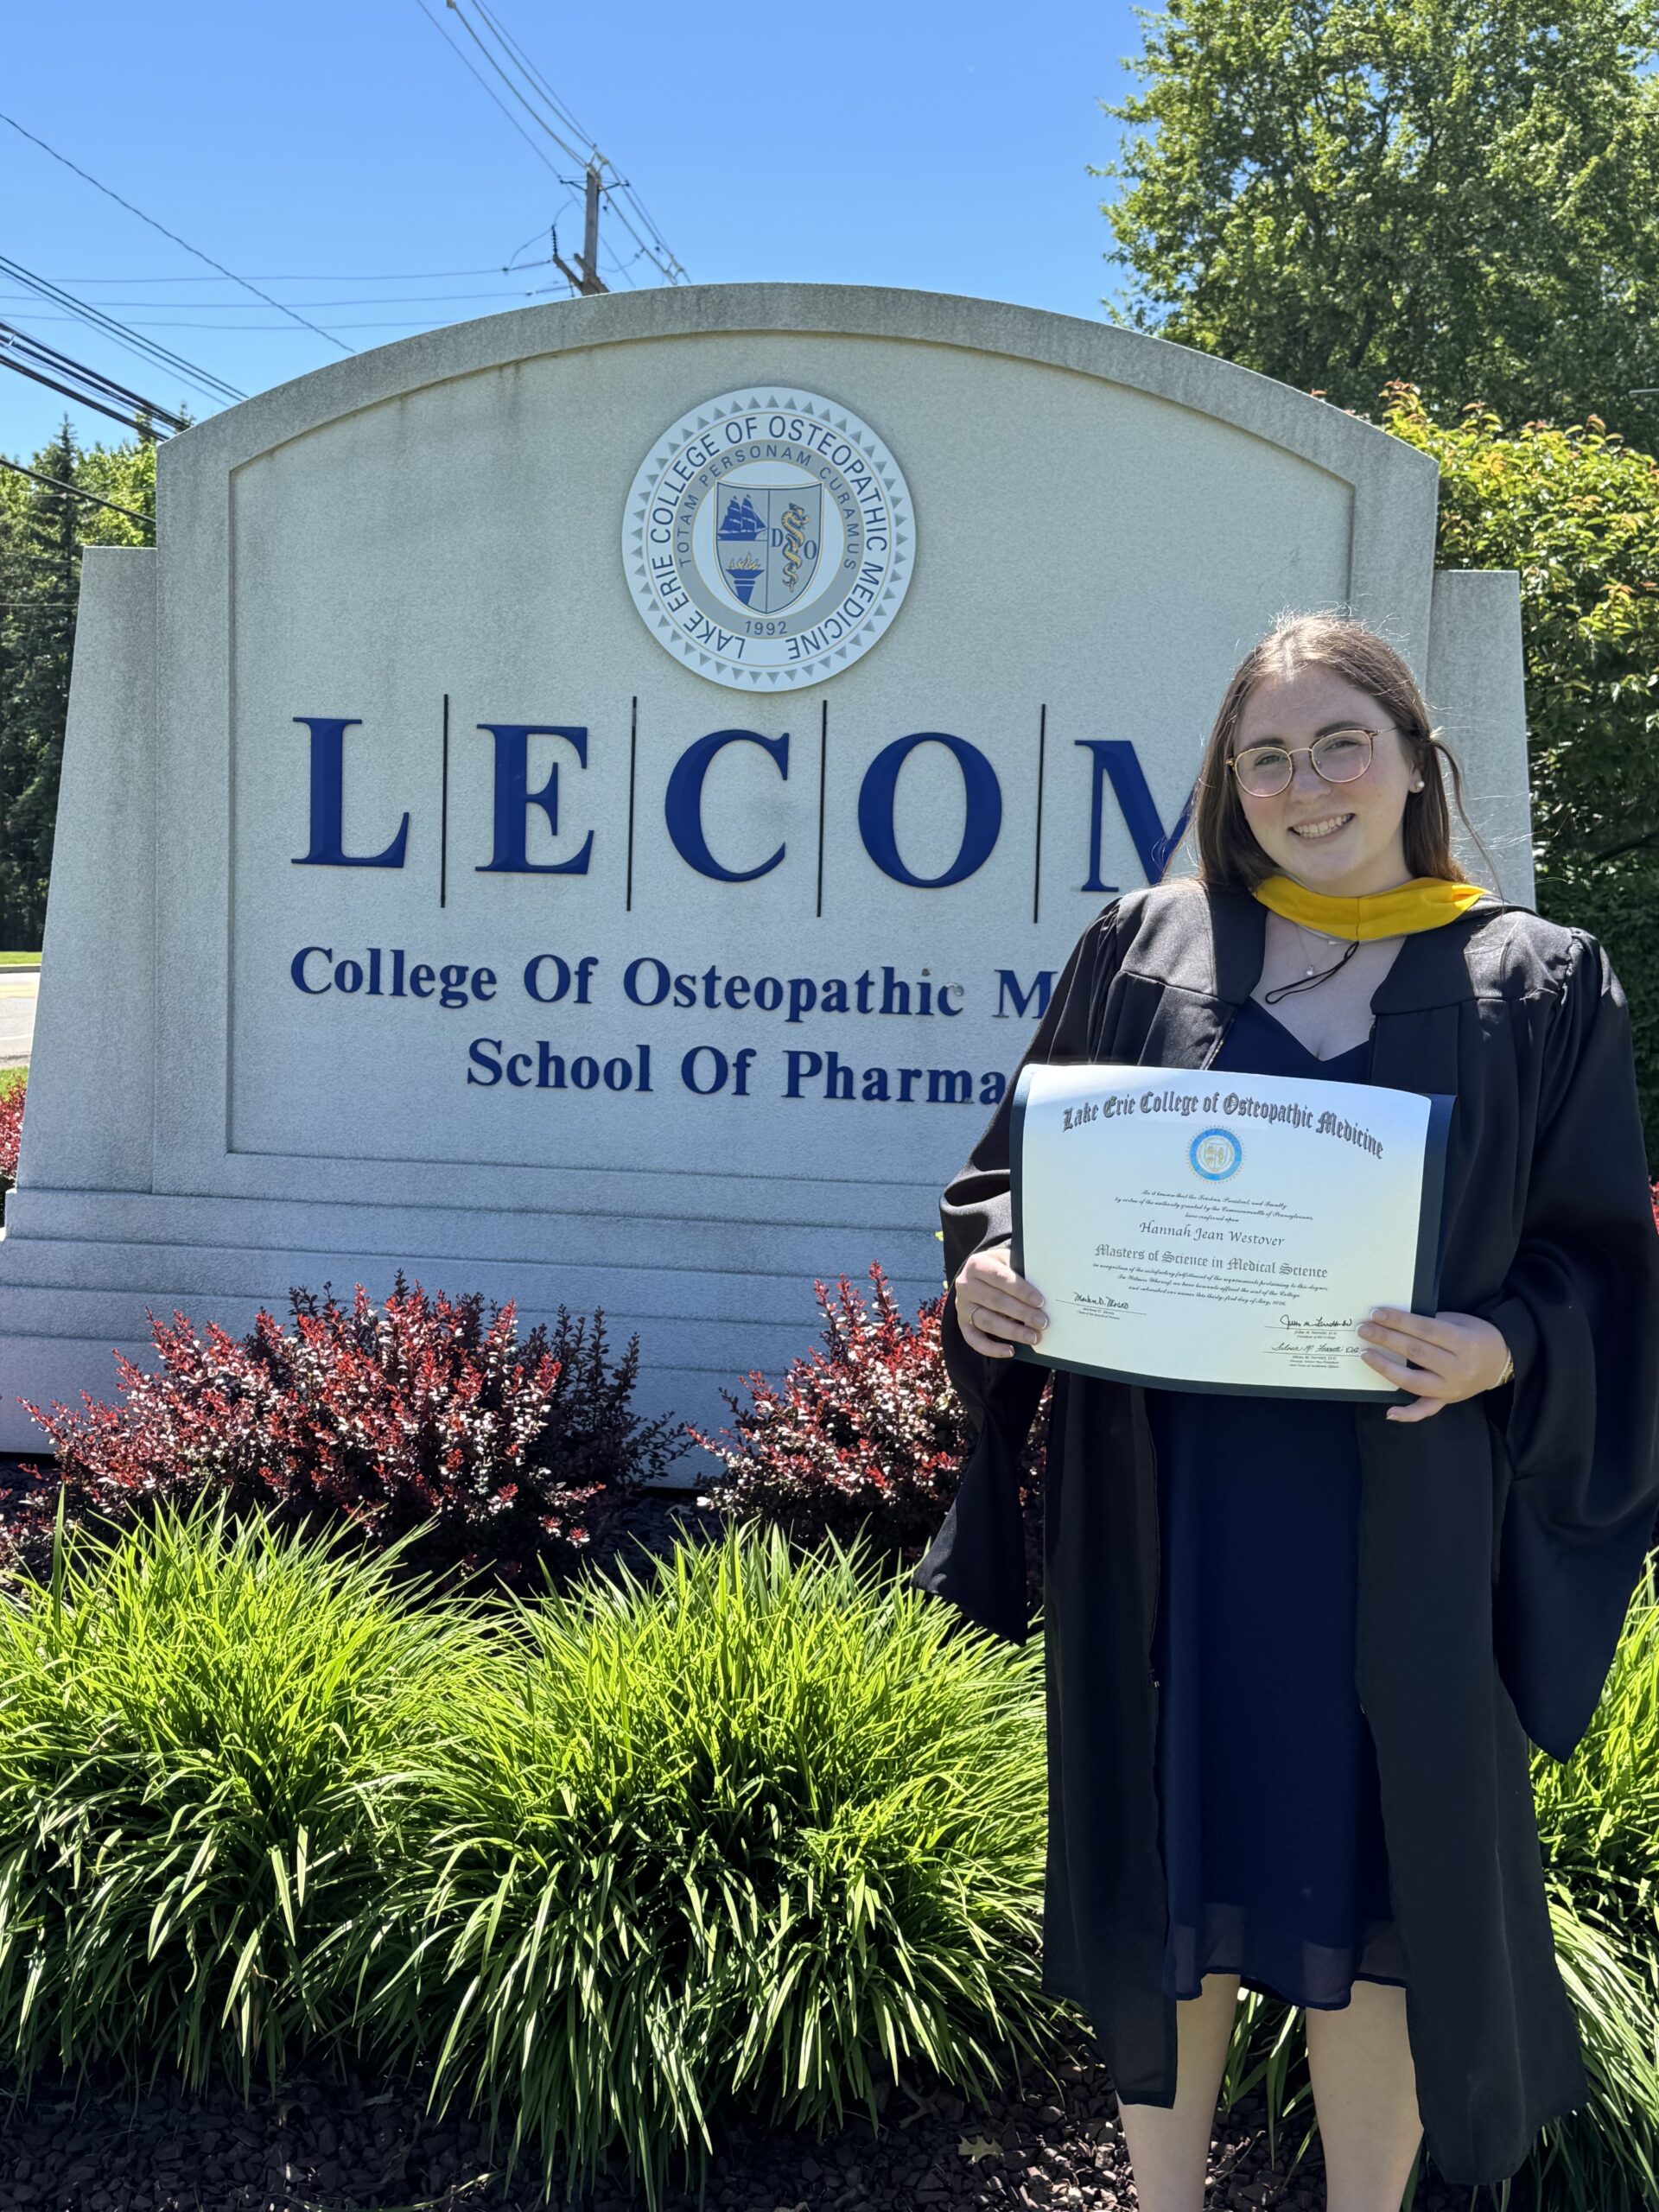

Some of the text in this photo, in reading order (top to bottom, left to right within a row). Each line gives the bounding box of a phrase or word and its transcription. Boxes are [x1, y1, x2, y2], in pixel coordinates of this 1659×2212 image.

[677, 444, 860, 570] TOTAM PERSONAM CURAMUS
[650, 415, 888, 660] LAKE ERIE COLLEGE OF OSTEOPATHIC MEDICINE
[771, 528, 817, 560] D O
[745, 620, 788, 636] 1992
[290, 946, 497, 1009] College
[524, 953, 598, 1006] Of
[624, 957, 965, 1023] Osteopathic
[467, 1038, 652, 1095] School
[681, 1045, 757, 1098] Of
[1062, 1090, 1384, 1160] Lake Erie College of Osteopathic Medicine
[1095, 1243, 1328, 1278] Masters of Science in Medical Science
[1140, 1220, 1286, 1246] Hannah Jean Westover
